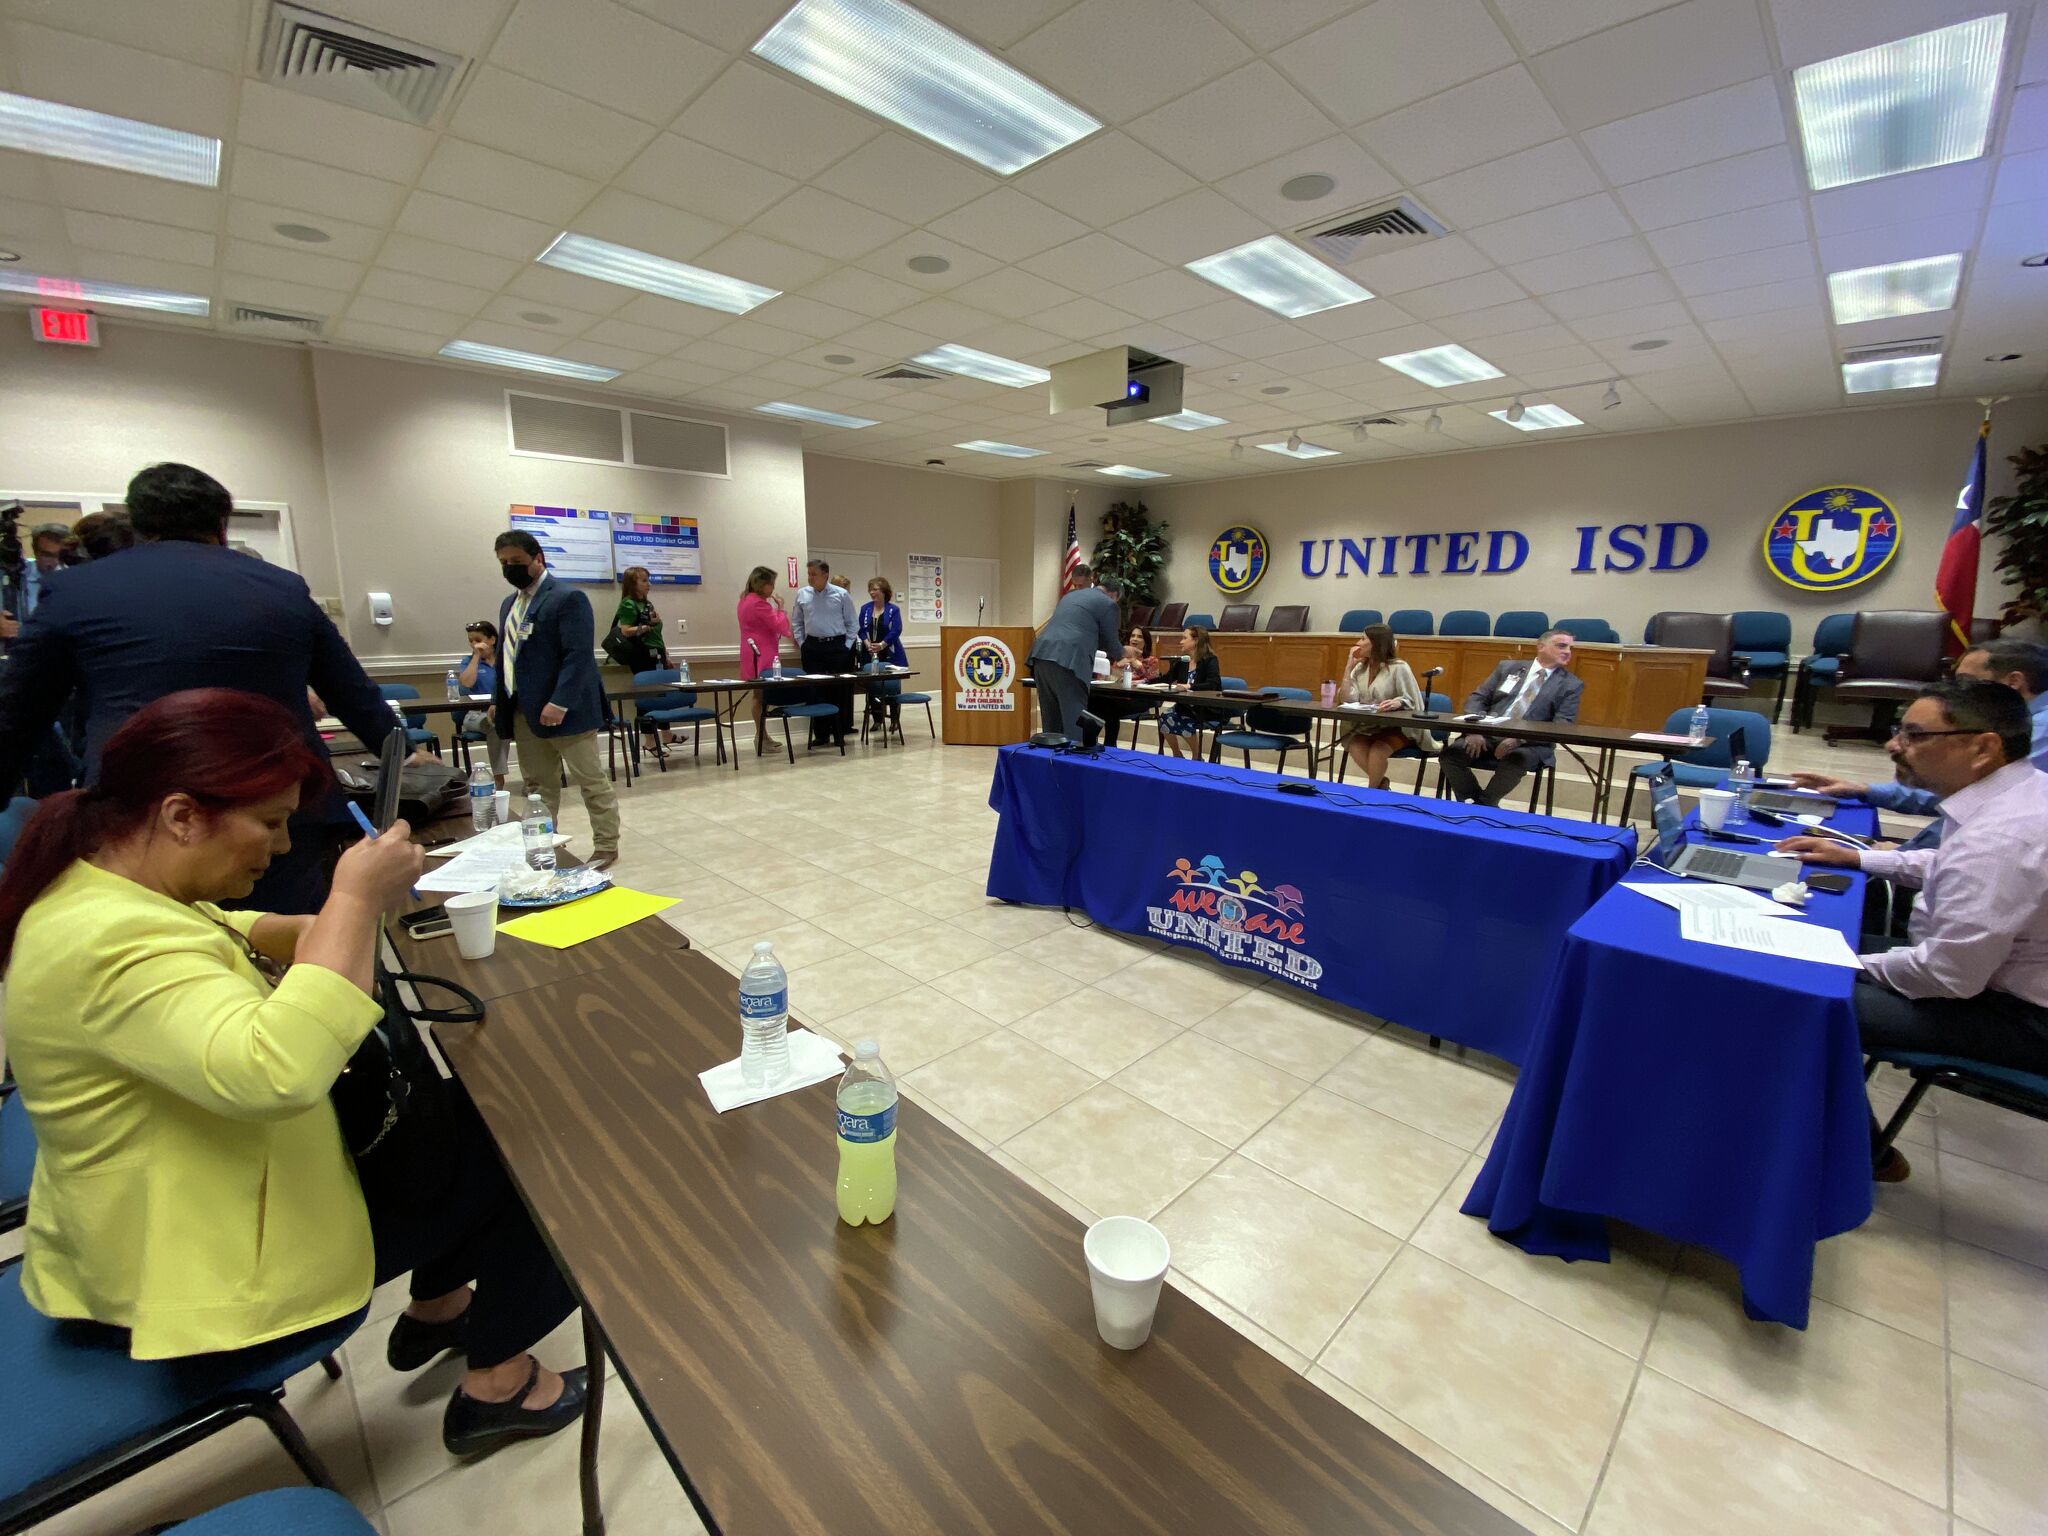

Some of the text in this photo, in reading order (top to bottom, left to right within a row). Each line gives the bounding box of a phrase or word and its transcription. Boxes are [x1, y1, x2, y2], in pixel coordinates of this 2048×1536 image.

[617, 534, 642, 543] UNITED
[1300, 522, 1709, 579] UNITED ISD
[1146, 906, 1323, 980] UNITED
[1169, 889, 1305, 945] we are
[1148, 926, 1318, 990] Independent School District
